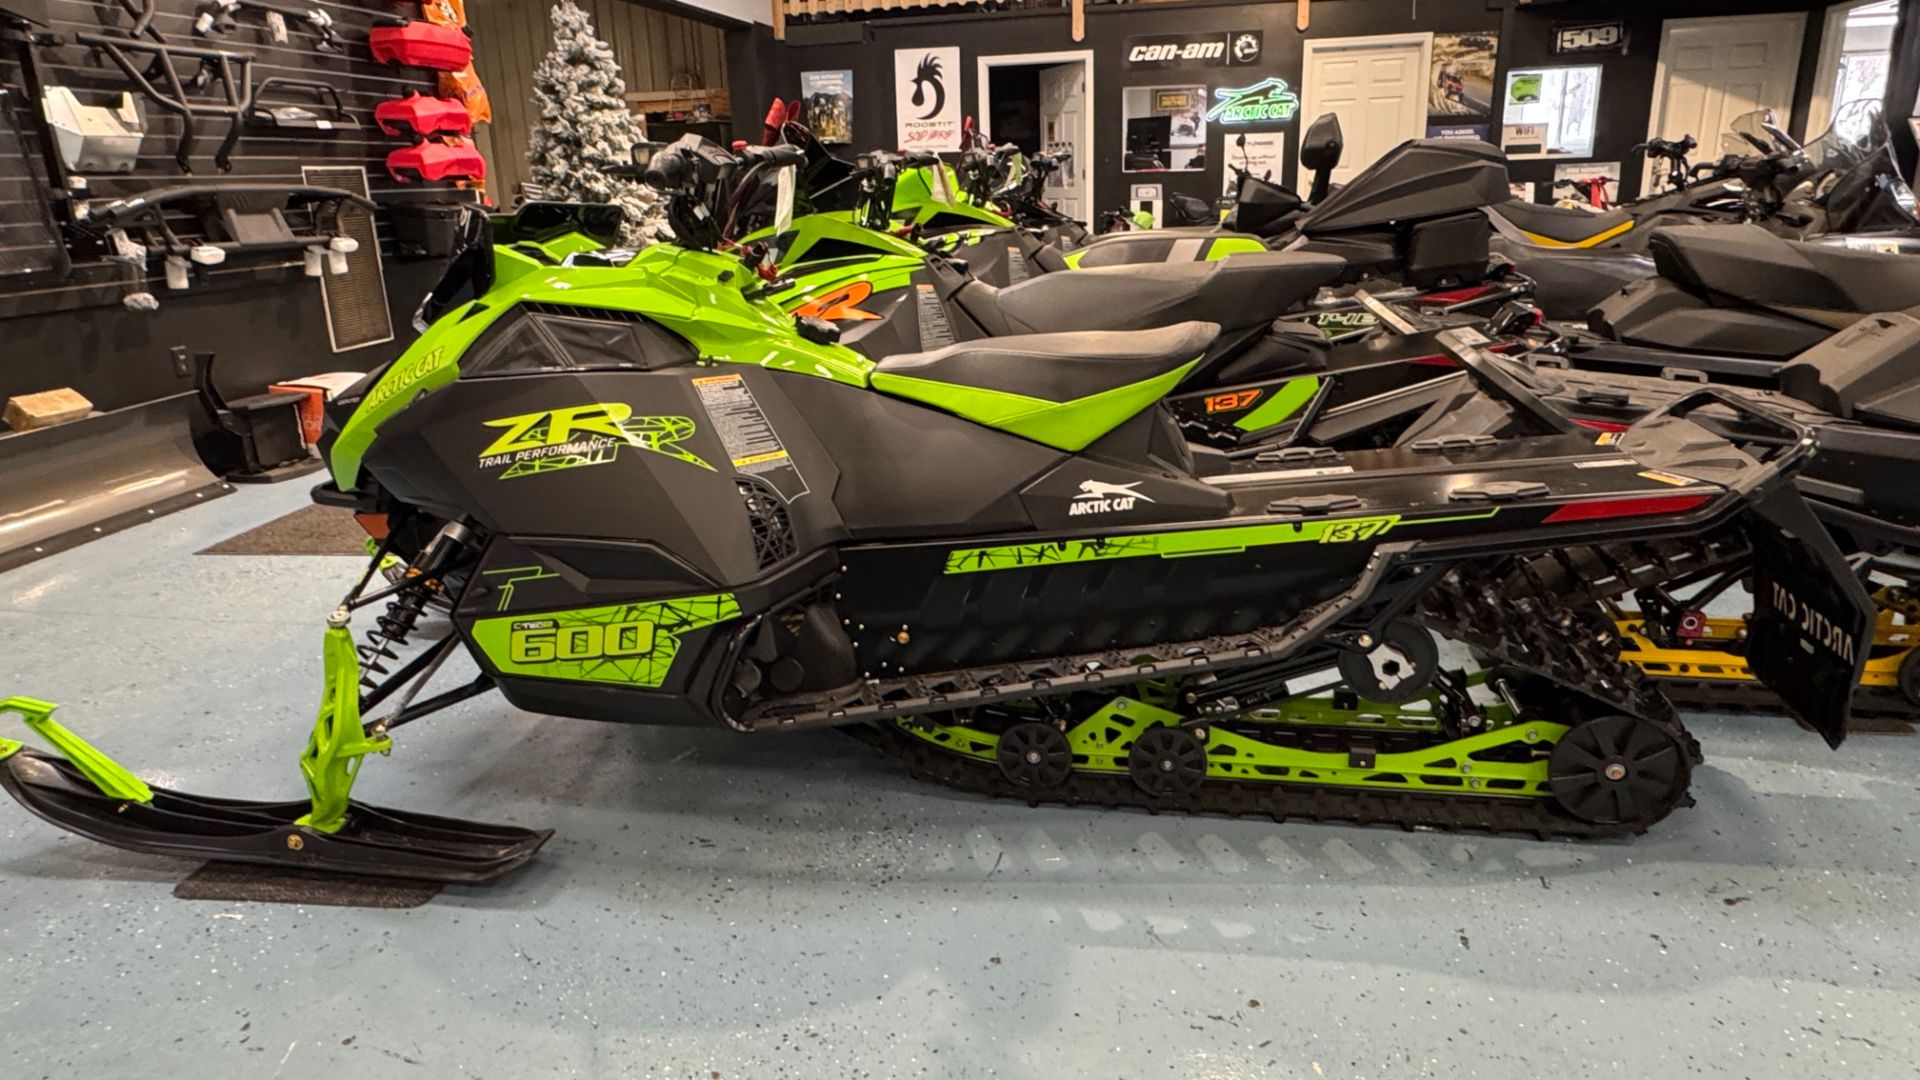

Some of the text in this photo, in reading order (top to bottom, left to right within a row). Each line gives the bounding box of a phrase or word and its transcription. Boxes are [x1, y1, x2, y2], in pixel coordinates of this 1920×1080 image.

[1561, 26, 1618, 49] 509
[1128, 41, 1225, 62] can-am
[1224, 102, 1294, 121] ARCTIC CAT
[366, 346, 445, 412] ARCTIC CAT
[1204, 388, 1262, 414] 137
[479, 402, 648, 458] ZR
[479, 436, 617, 469] TRAIL PERFORMANCE
[1068, 496, 1136, 516] ARCTIC CAT
[1319, 520, 1387, 544] 137
[510, 619, 655, 664] 600
